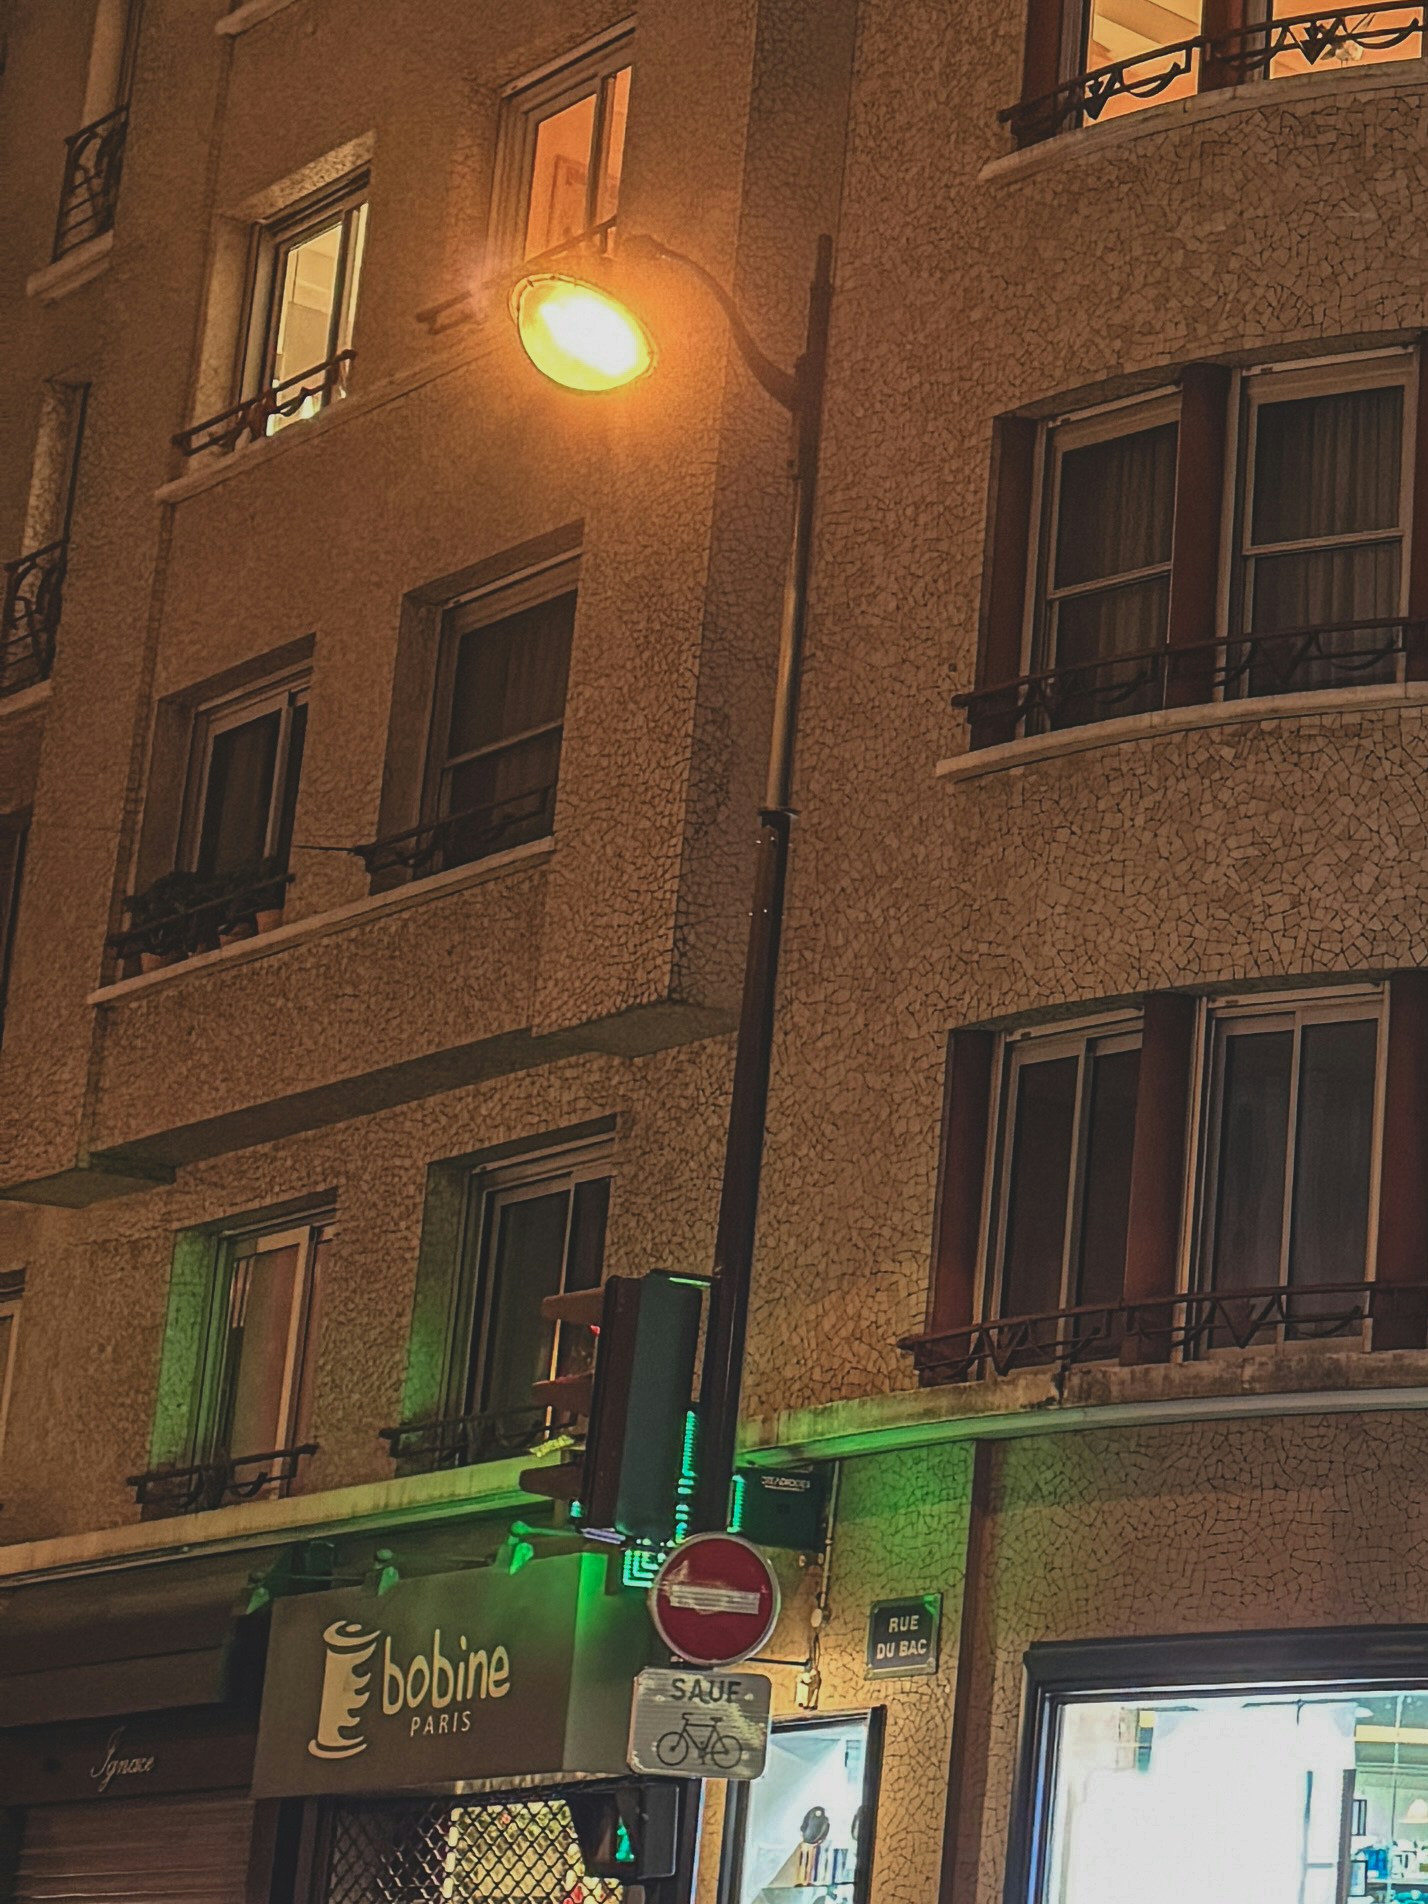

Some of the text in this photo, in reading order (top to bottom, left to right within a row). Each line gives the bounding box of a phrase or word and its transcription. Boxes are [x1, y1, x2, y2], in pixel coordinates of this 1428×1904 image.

[888, 1615, 919, 1633] RUE
[876, 1639, 927, 1659] DU BAC
[383, 1628, 510, 1715] bobine
[670, 1678, 742, 1704] SAUF
[410, 1711, 471, 1737] PARIS
